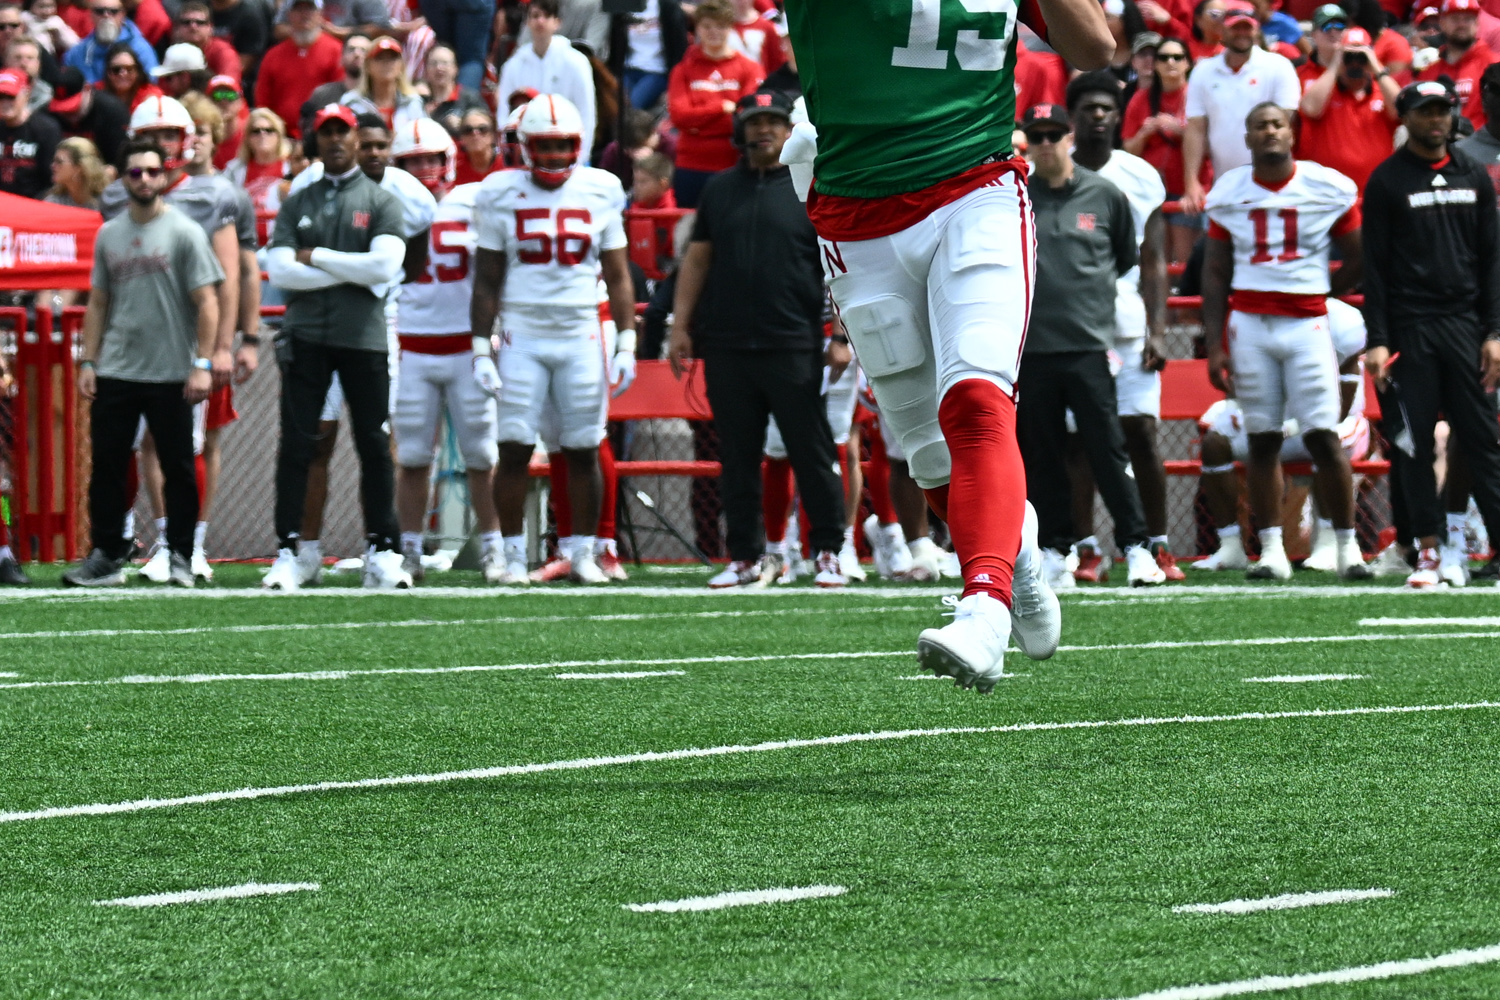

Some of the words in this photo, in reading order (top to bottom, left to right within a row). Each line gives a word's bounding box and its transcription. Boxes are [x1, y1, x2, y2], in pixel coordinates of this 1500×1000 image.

[515, 208, 592, 267] 56
[823, 240, 849, 279] N
[1246, 206, 1305, 266] 11
